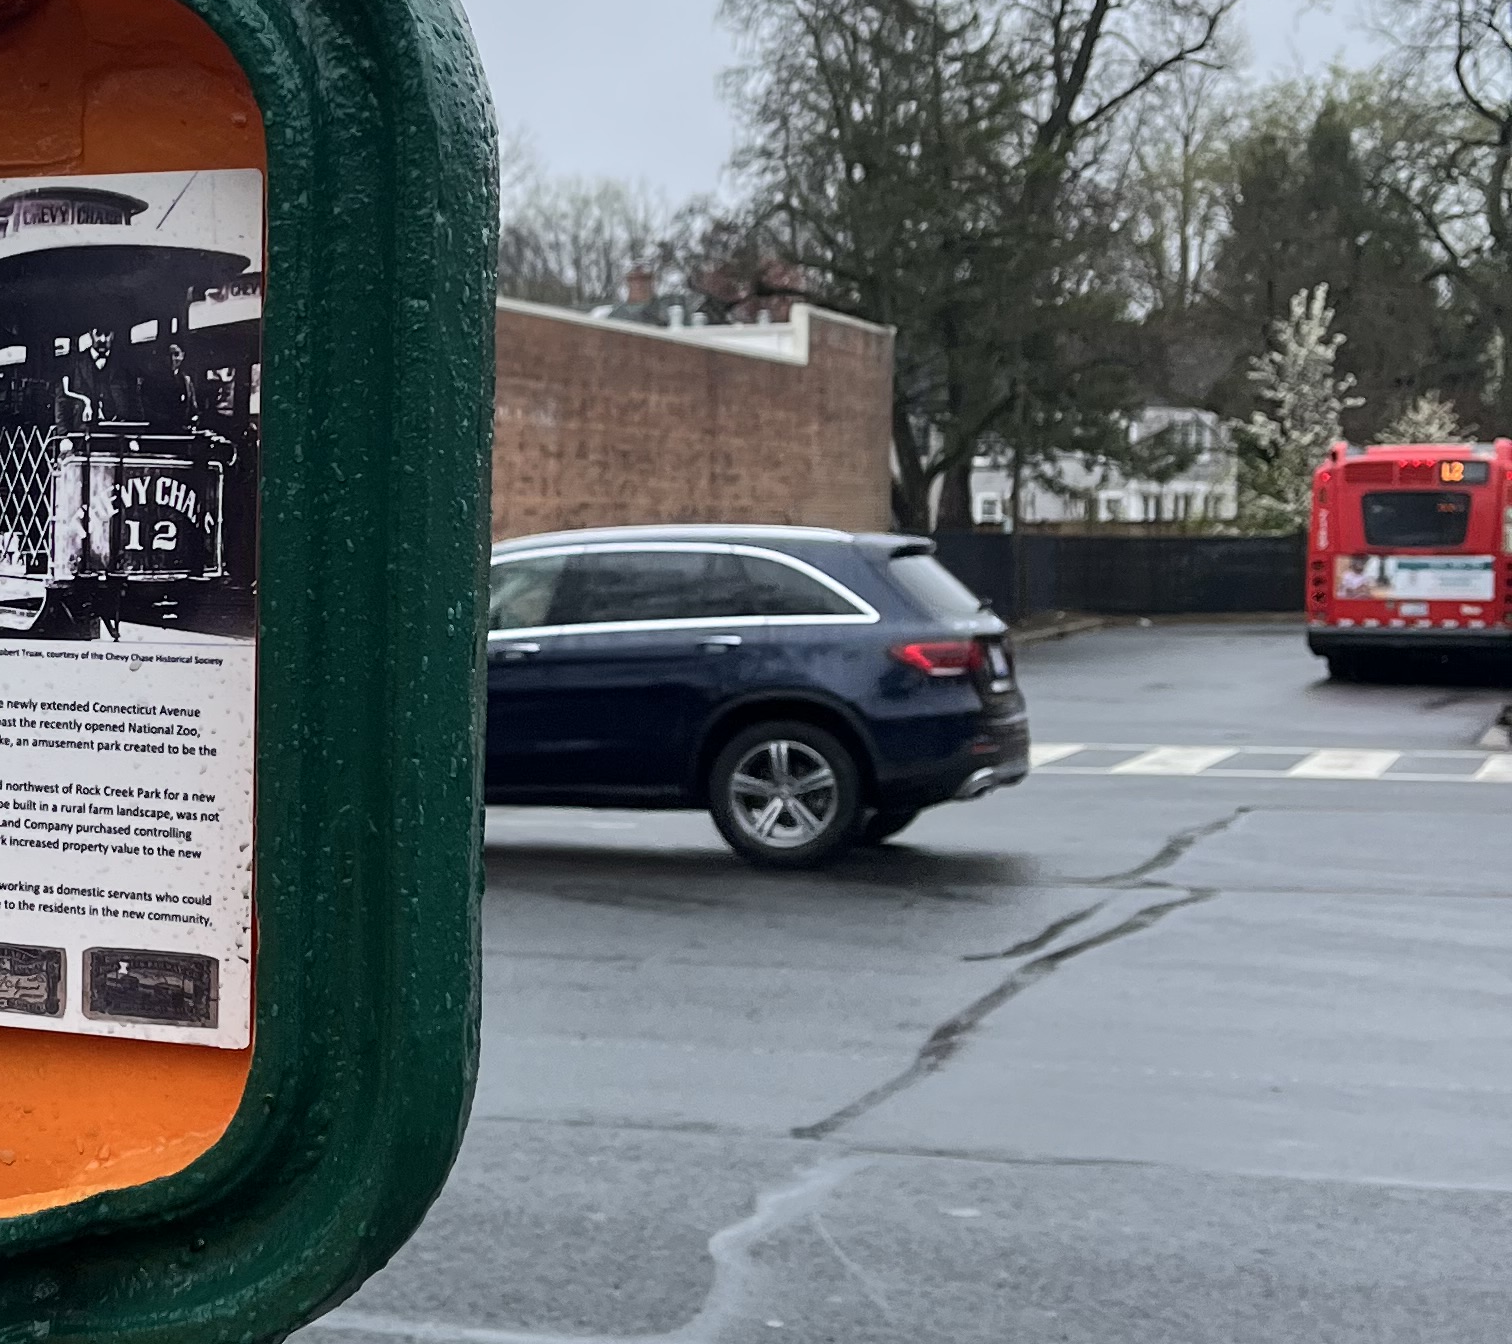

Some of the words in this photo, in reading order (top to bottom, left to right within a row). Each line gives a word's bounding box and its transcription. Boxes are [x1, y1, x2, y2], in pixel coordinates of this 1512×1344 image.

[154, 476, 215, 535] CHA
[124, 520, 178, 551] 12
[5, 697, 38, 713] newly
[39, 699, 90, 713] extended
[91, 701, 158, 716] Connecticut
[158, 704, 201, 718] Avenue
[18, 715, 37, 729] the
[38, 717, 83, 733] recently
[83, 720, 126, 734] opened
[127, 721, 175, 735] National
[175, 723, 201, 739] Zoo,
[4, 779, 60, 794] northwest
[60, 782, 74, 795] of
[74, 782, 101, 796] Rock
[102, 784, 135, 798] Creek
[136, 786, 162, 800] Park
[162, 787, 180, 801] for
[181, 791, 189, 802] a
[190, 792, 216, 803] new
[23, 817, 74, 835] Company
[74, 821, 131, 836] purchased
[132, 825, 192, 842] controlling
[41, 884, 55, 895] as
[55, 882, 106, 898] domestic
[106, 889, 153, 902] servants
[154, 890, 180, 904] who
[181, 893, 212, 906] could
[3, 898, 16, 910] to
[17, 898, 36, 912] the
[37, 901, 86, 916] residents
[88, 904, 99, 917] in
[100, 904, 120, 918] the
[121, 909, 146, 920] new
[146, 910, 213, 928] community,
